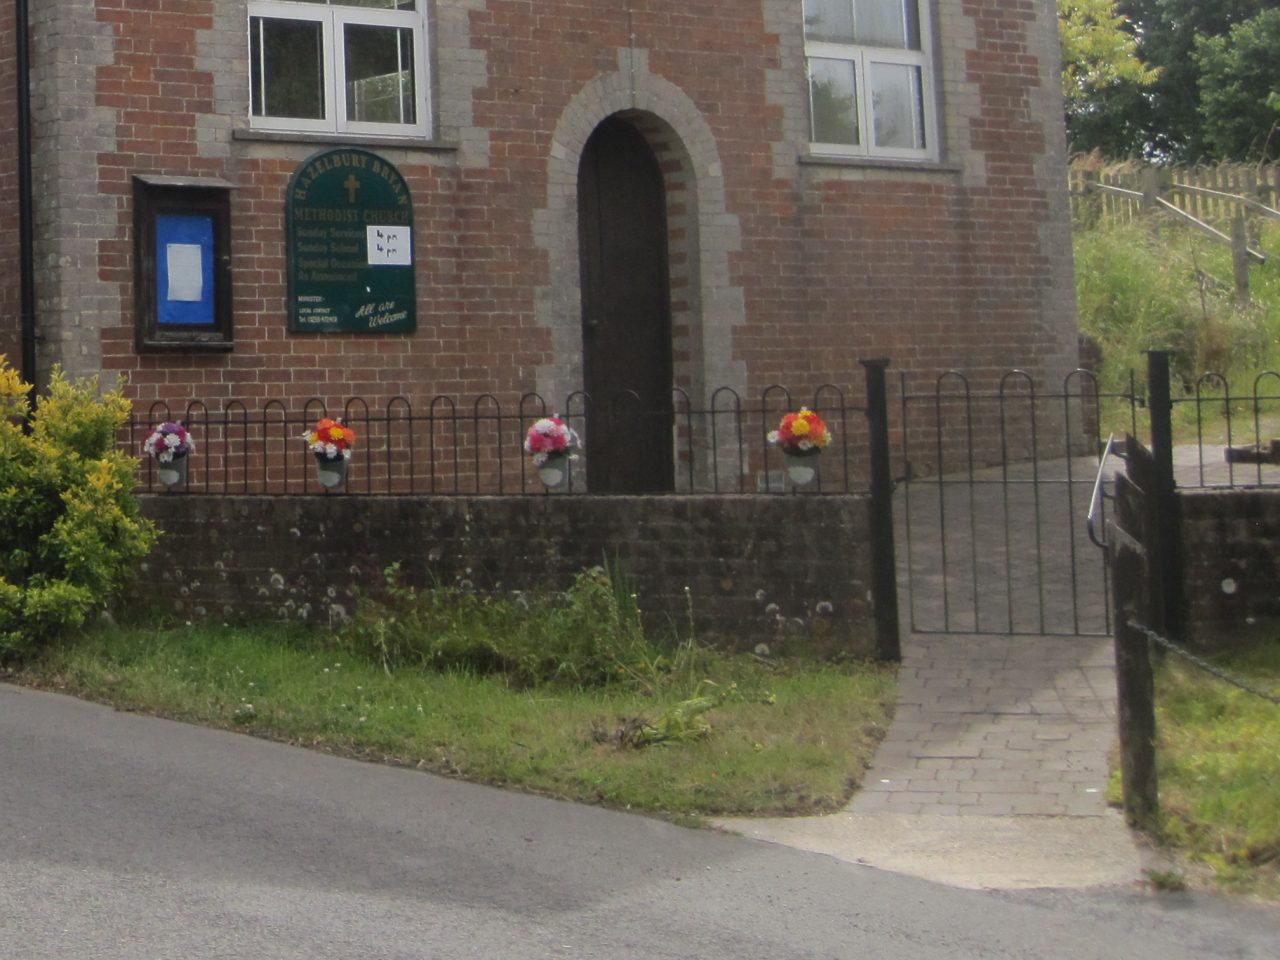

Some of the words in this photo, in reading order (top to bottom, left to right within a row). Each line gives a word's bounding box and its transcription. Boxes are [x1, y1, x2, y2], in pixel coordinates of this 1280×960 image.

[294, 154, 368, 200] HAZELBURY
[372, 160, 408, 205] BRYAN
[294, 208, 358, 222] METHODIST
[363, 209, 409, 223] CHURCH
[377, 230, 384, 239] 4
[377, 243, 384, 252] 4
[355, 303, 375, 318] All
[378, 301, 395, 312] are
[369, 311, 407, 328] Welcome
